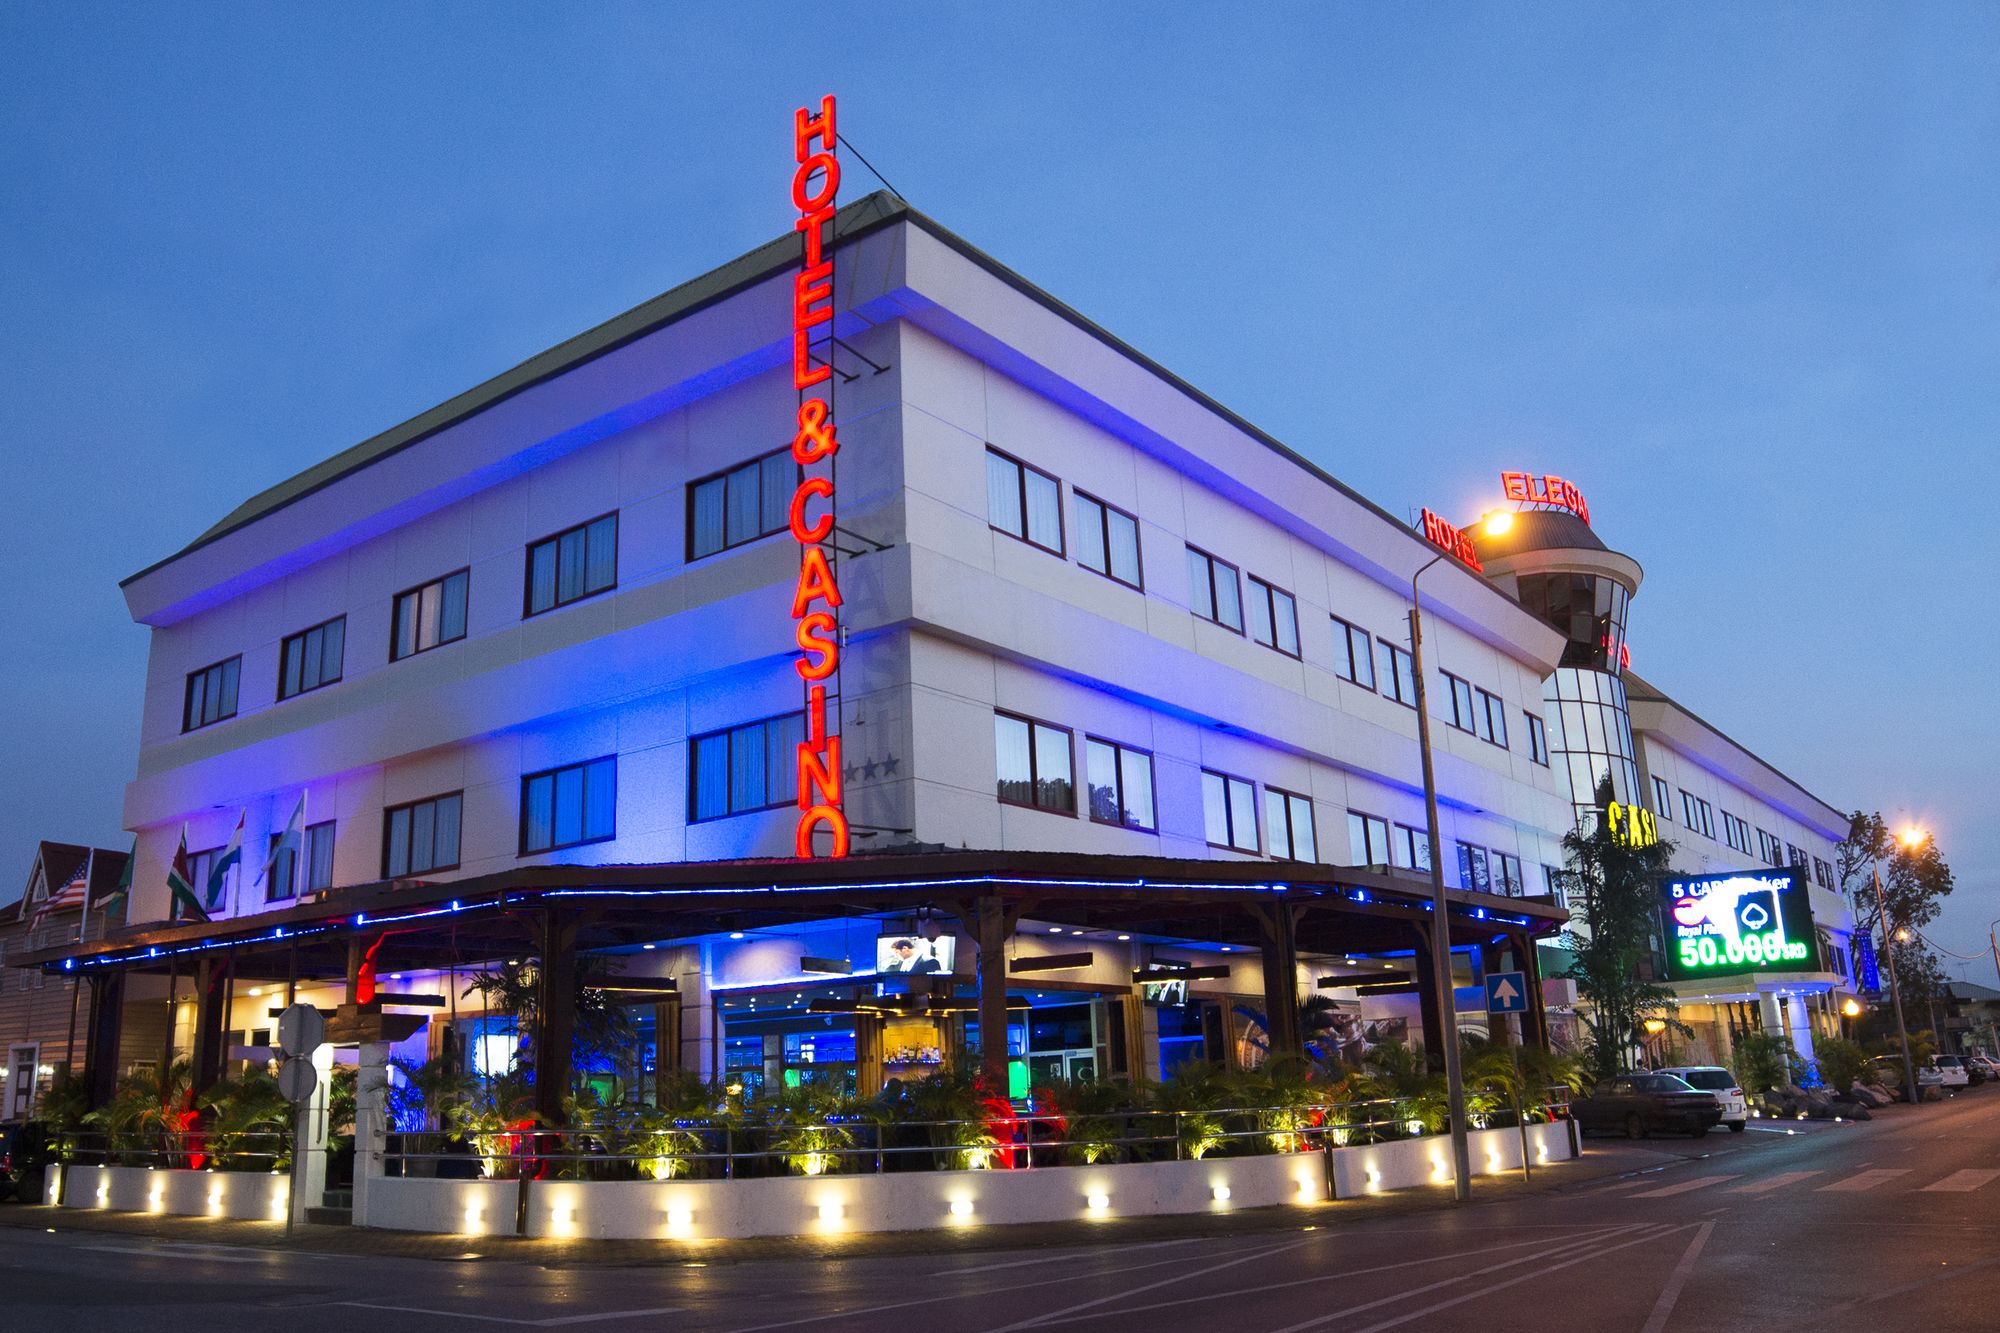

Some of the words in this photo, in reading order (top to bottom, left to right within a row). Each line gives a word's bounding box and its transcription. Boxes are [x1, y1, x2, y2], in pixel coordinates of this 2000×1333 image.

[791, 94, 840, 390] HOTEL
[791, 397, 840, 466] &
[1422, 506, 1484, 573] HOTEL
[789, 476, 849, 859] CASINO
[1672, 883, 1685, 897] 5
[1680, 932, 1783, 967] 50.000
